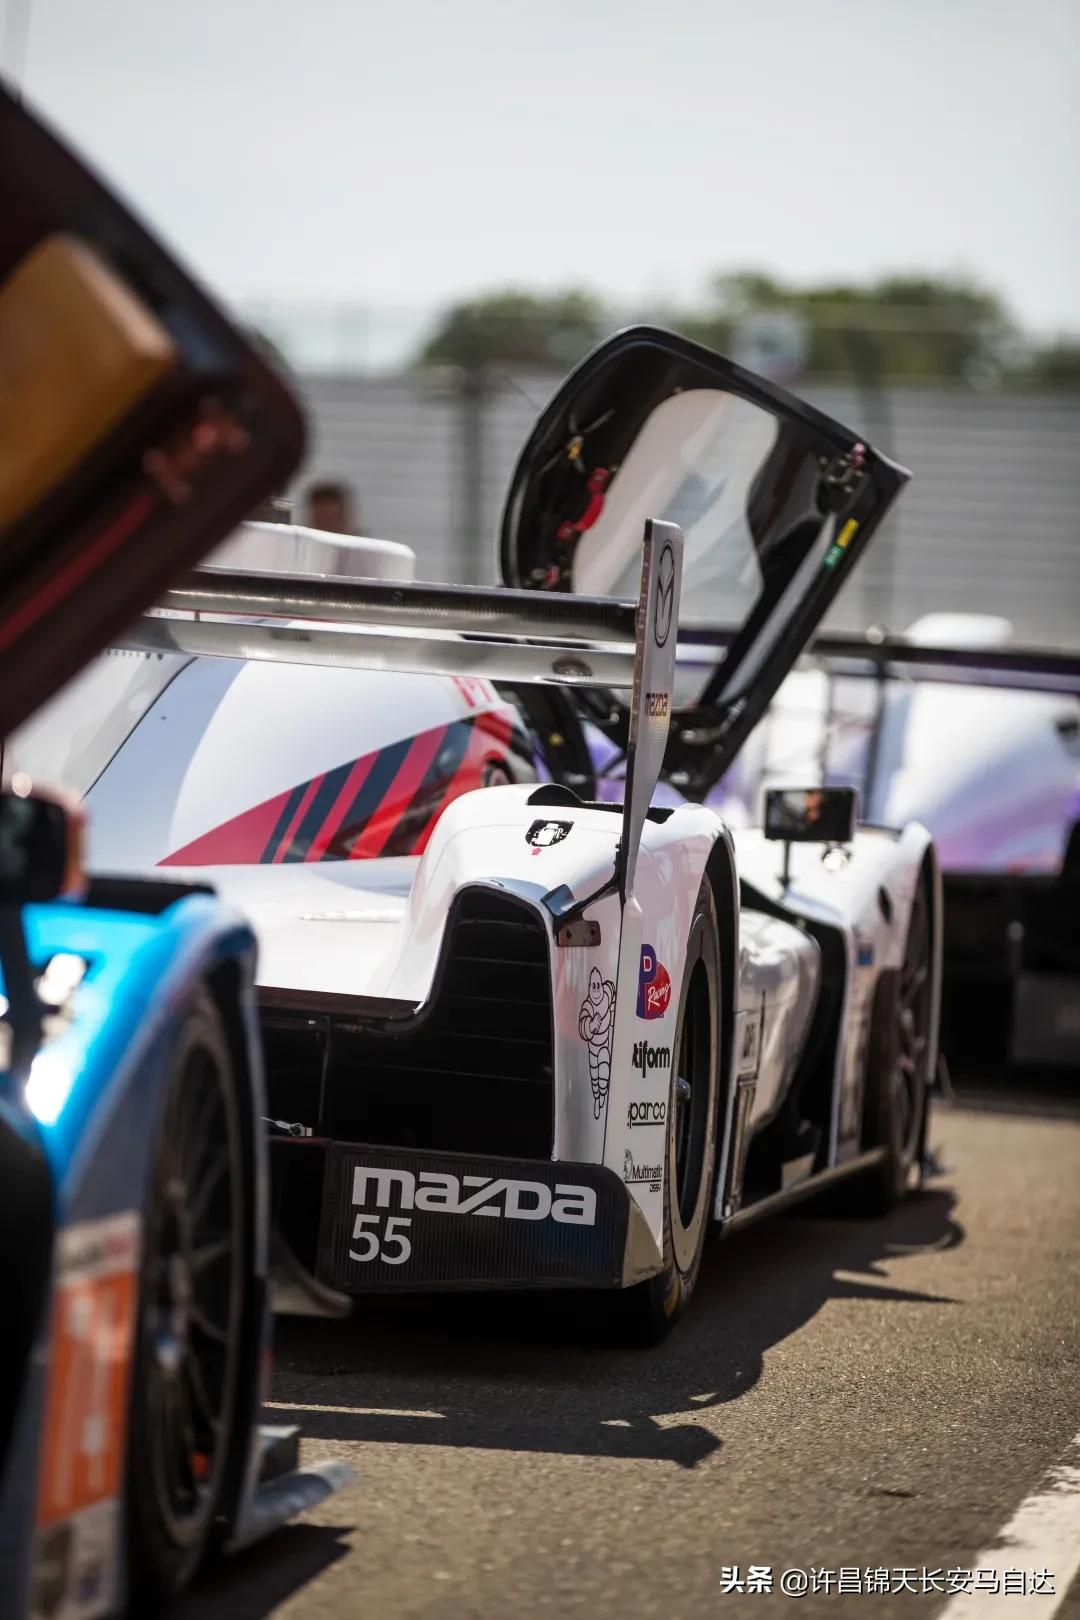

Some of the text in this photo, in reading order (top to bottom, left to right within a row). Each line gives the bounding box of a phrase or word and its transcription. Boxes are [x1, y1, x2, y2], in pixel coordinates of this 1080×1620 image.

[632, 1040, 671, 1079] tiform
[627, 1101, 666, 1129] parco
[349, 1213, 412, 1265] 55
